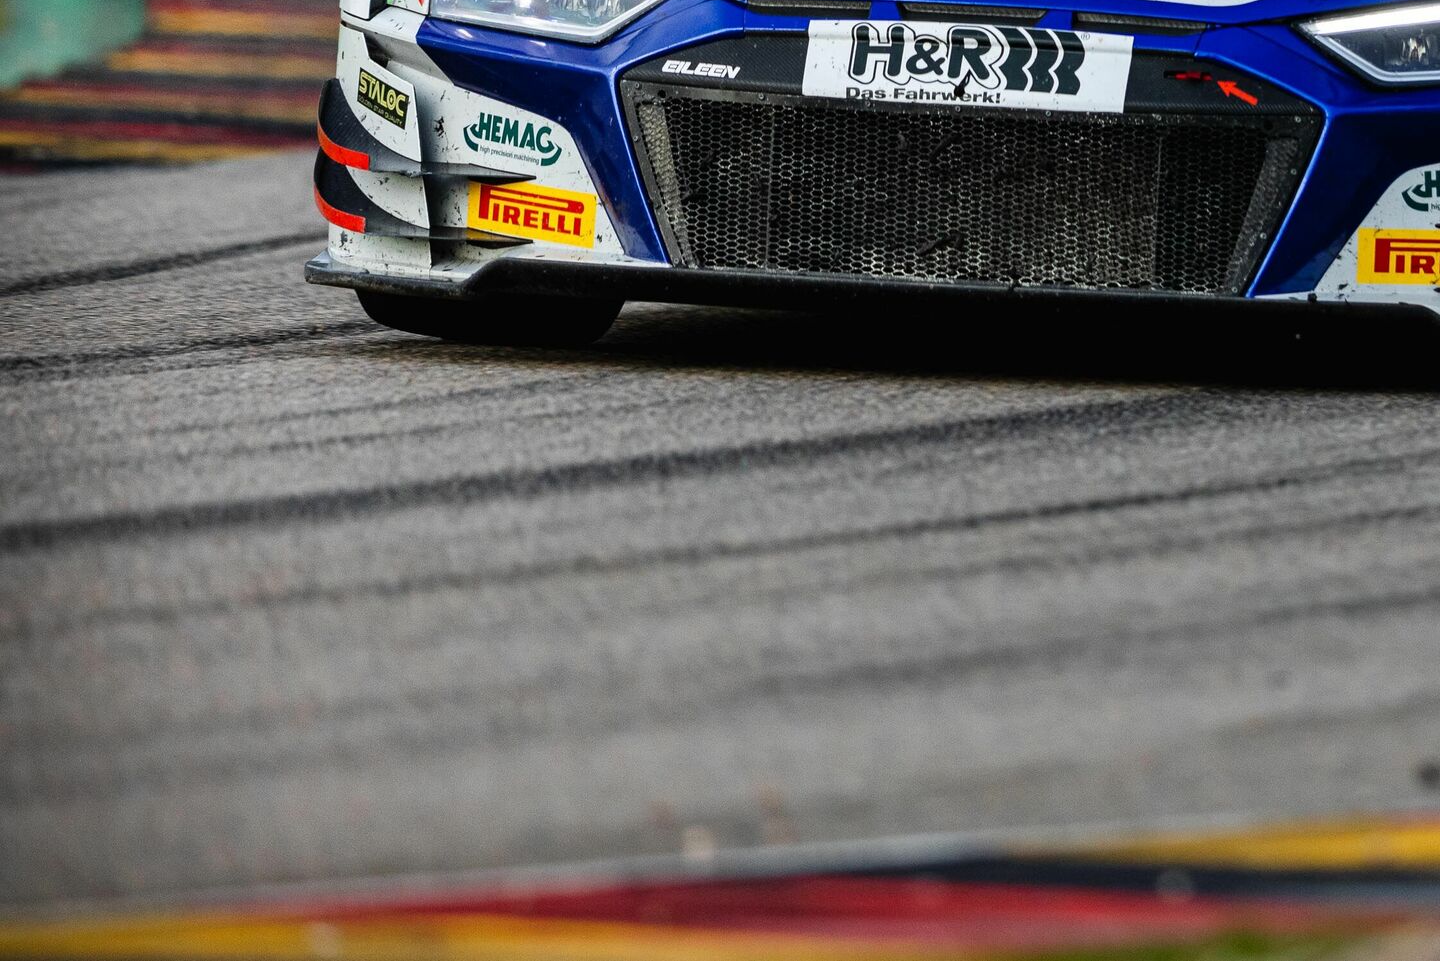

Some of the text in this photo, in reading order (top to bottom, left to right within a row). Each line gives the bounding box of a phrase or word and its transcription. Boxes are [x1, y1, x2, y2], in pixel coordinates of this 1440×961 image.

[661, 59, 741, 79] EILEEN
[850, 23, 1002, 87] H&R
[359, 71, 406, 117] STALOC
[846, 86, 883, 100] Das
[470, 111, 555, 154] HEMAC
[480, 145, 540, 165] high precision machining
[478, 183, 585, 236] PIRELLI
